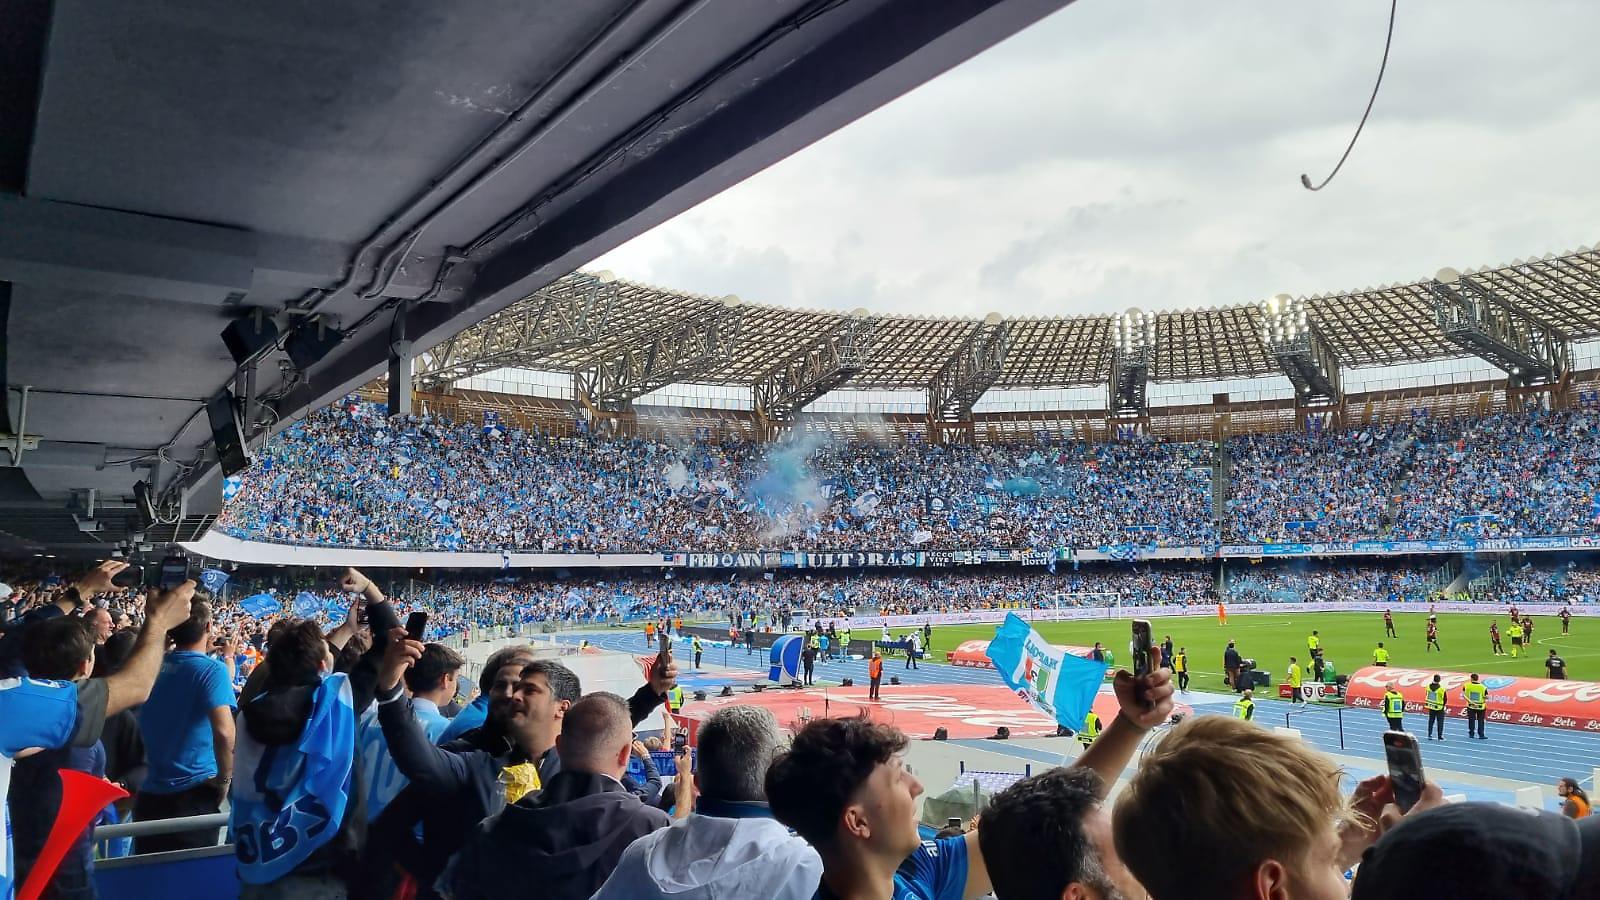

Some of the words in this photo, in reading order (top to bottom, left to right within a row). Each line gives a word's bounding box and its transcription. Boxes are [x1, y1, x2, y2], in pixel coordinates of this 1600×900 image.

[1352, 697, 1372, 706] Lete
[1487, 710, 1512, 721] Lete
[1519, 713, 1544, 725] Lete
[1551, 716, 1577, 728] Lete
